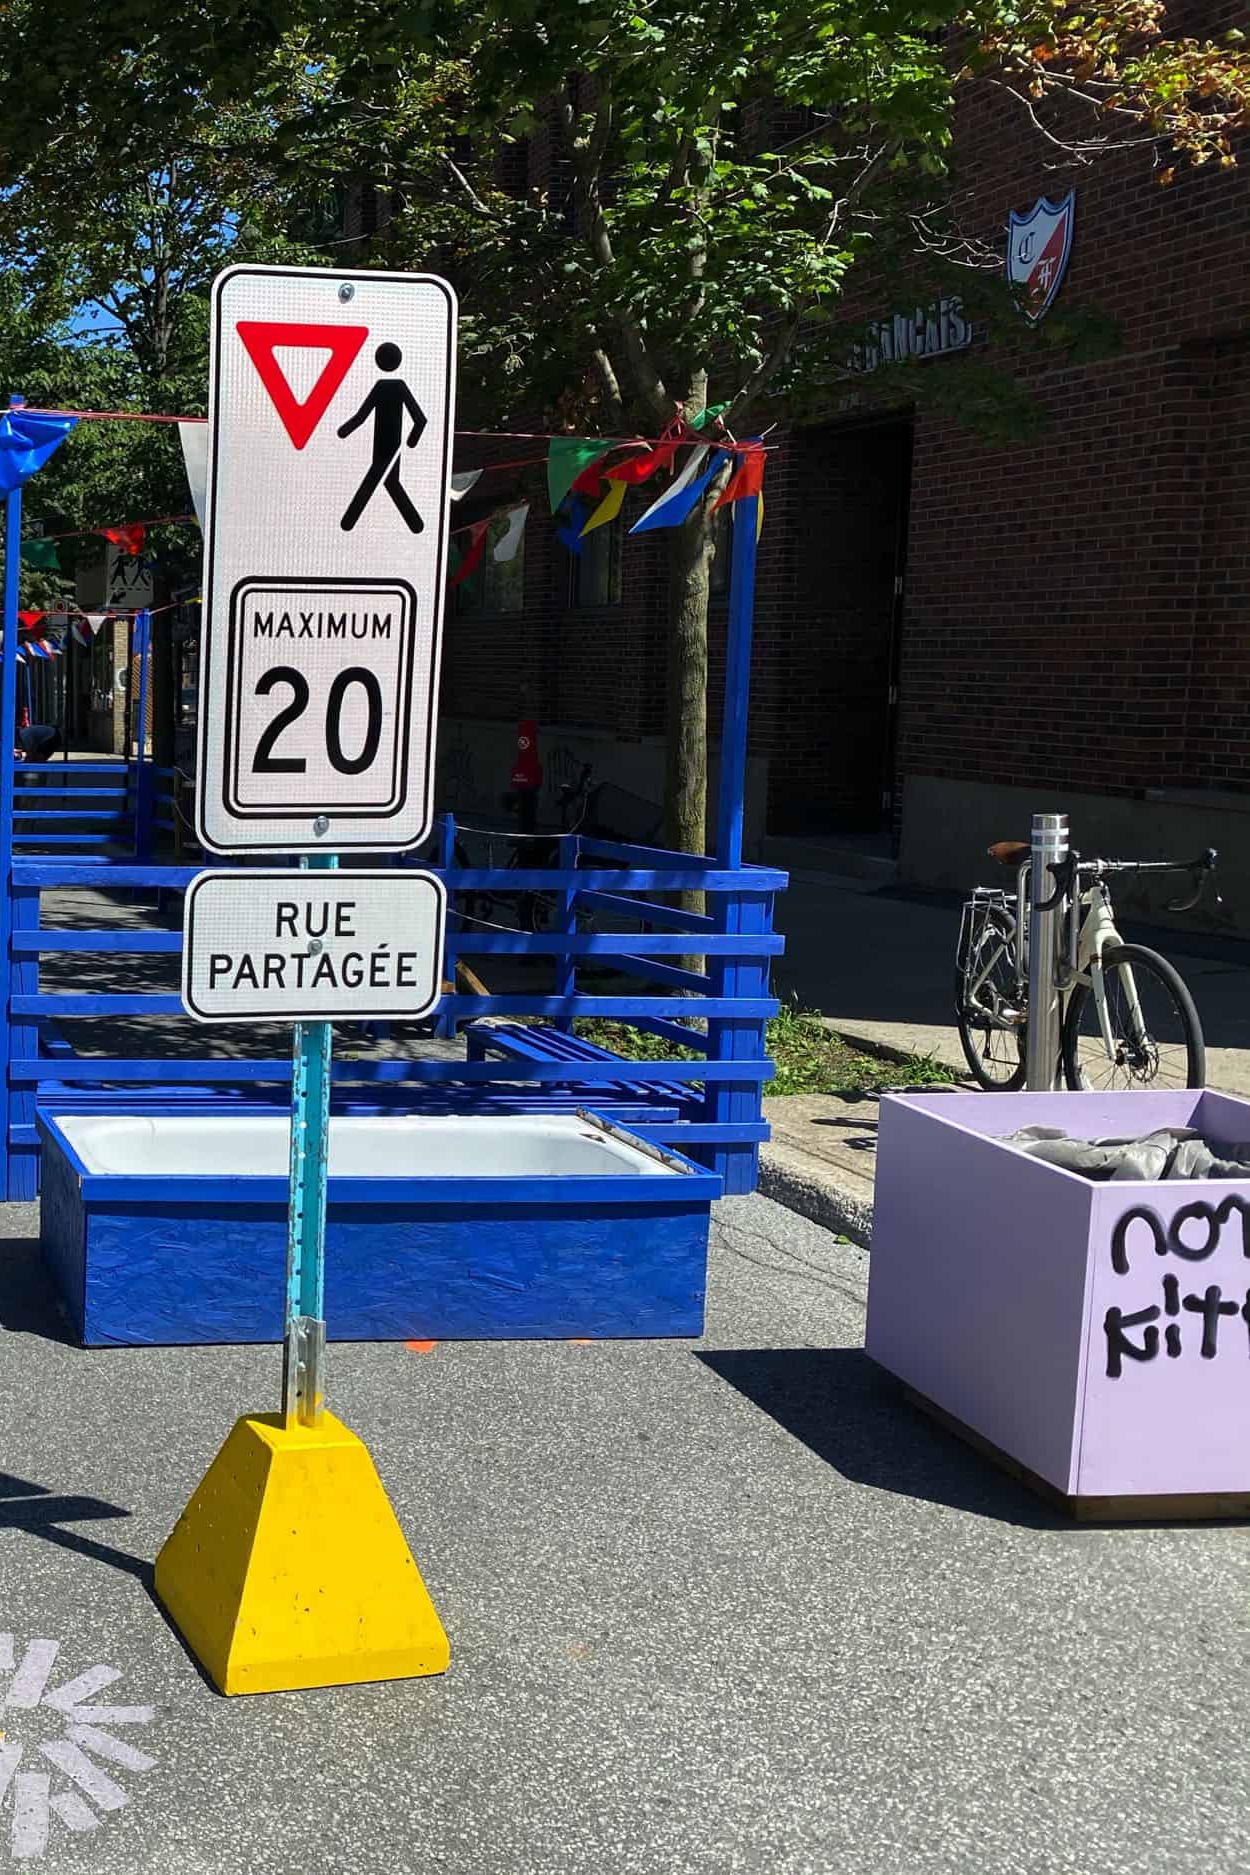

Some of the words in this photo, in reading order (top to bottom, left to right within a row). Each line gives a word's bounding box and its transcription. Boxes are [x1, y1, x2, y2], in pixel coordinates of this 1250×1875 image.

[253, 611, 392, 639] MAXIMUM
[252, 666, 383, 775] 20
[276, 901, 356, 938] RUE
[209, 943, 418, 990] PARTAGÉE
